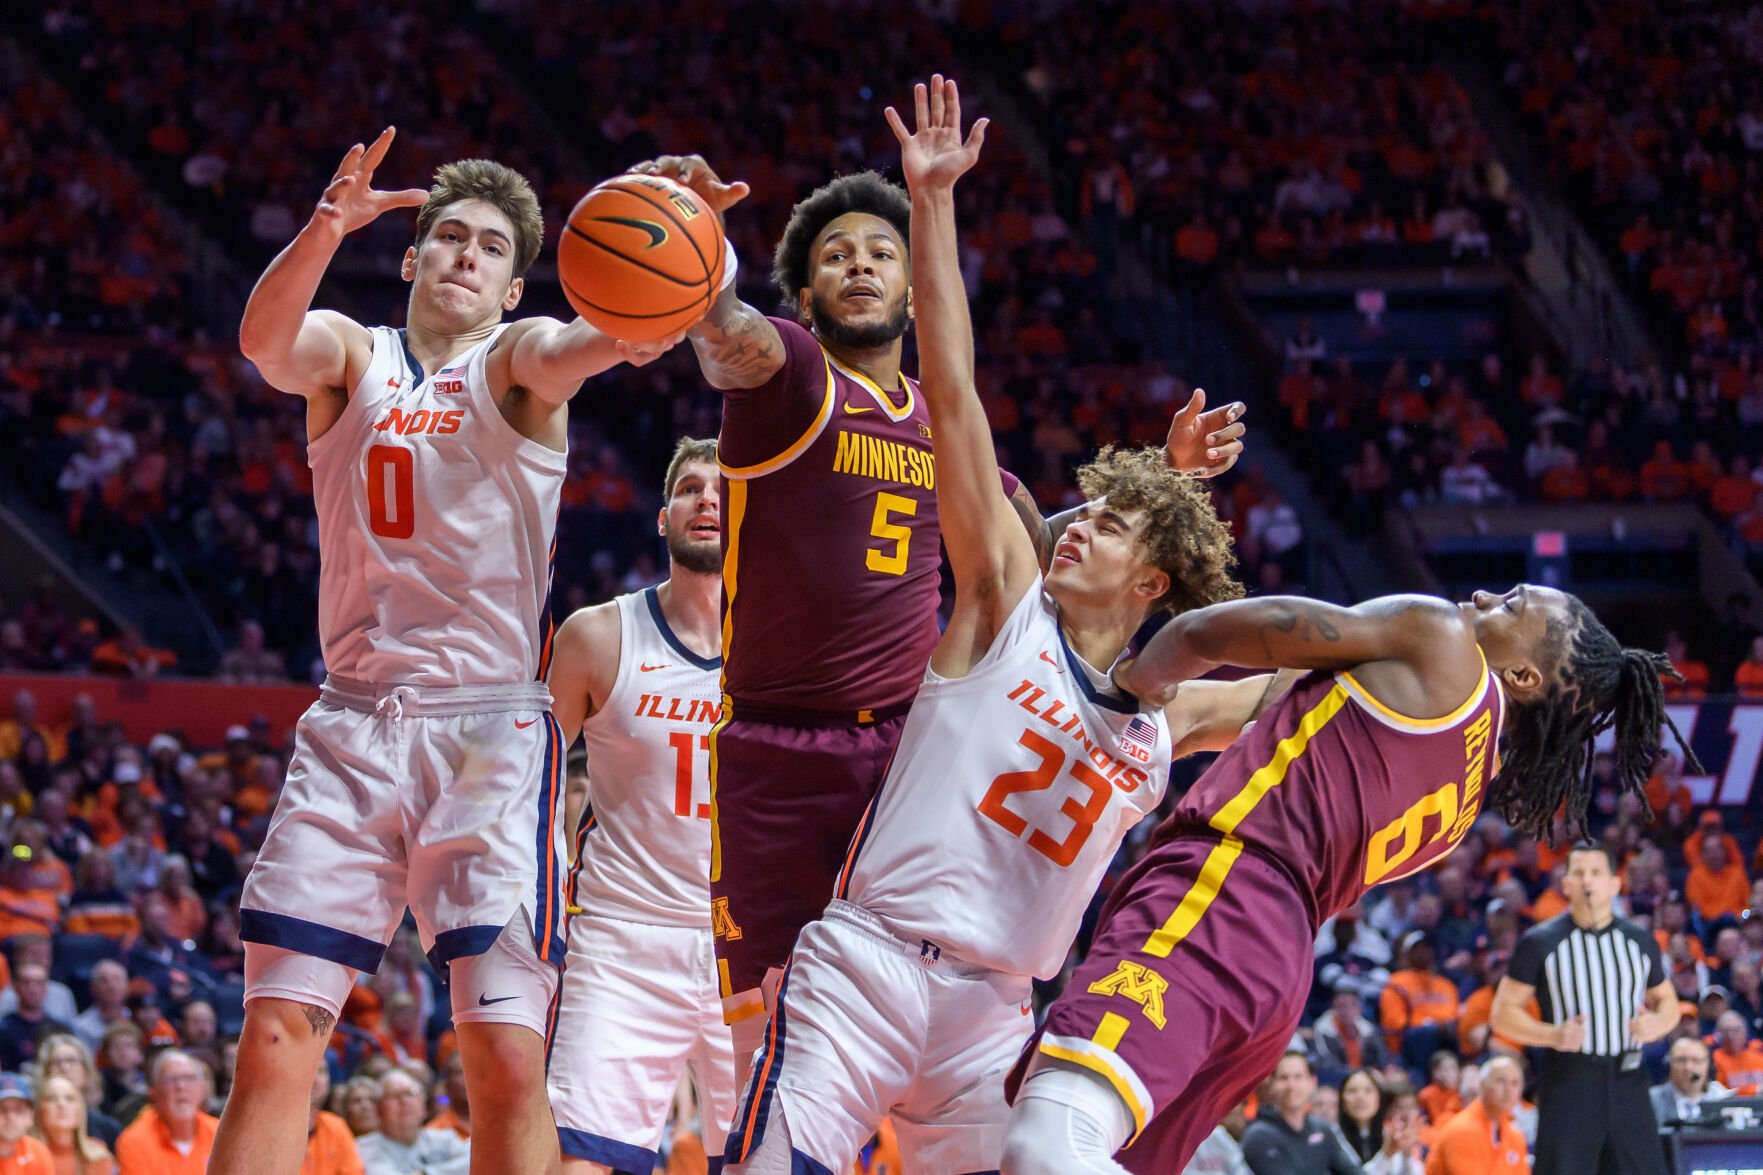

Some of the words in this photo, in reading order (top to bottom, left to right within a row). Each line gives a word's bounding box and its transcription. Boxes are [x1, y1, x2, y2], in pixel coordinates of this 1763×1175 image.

[371, 407, 465, 436] NOIS
[833, 430, 935, 490] MINNESO
[367, 444, 415, 540] 0
[865, 491, 918, 576] 5
[634, 694, 722, 724] ILLIN
[1007, 679, 1149, 794] ILLINOIS
[668, 731, 711, 820] 1
[977, 727, 1113, 868] 23
